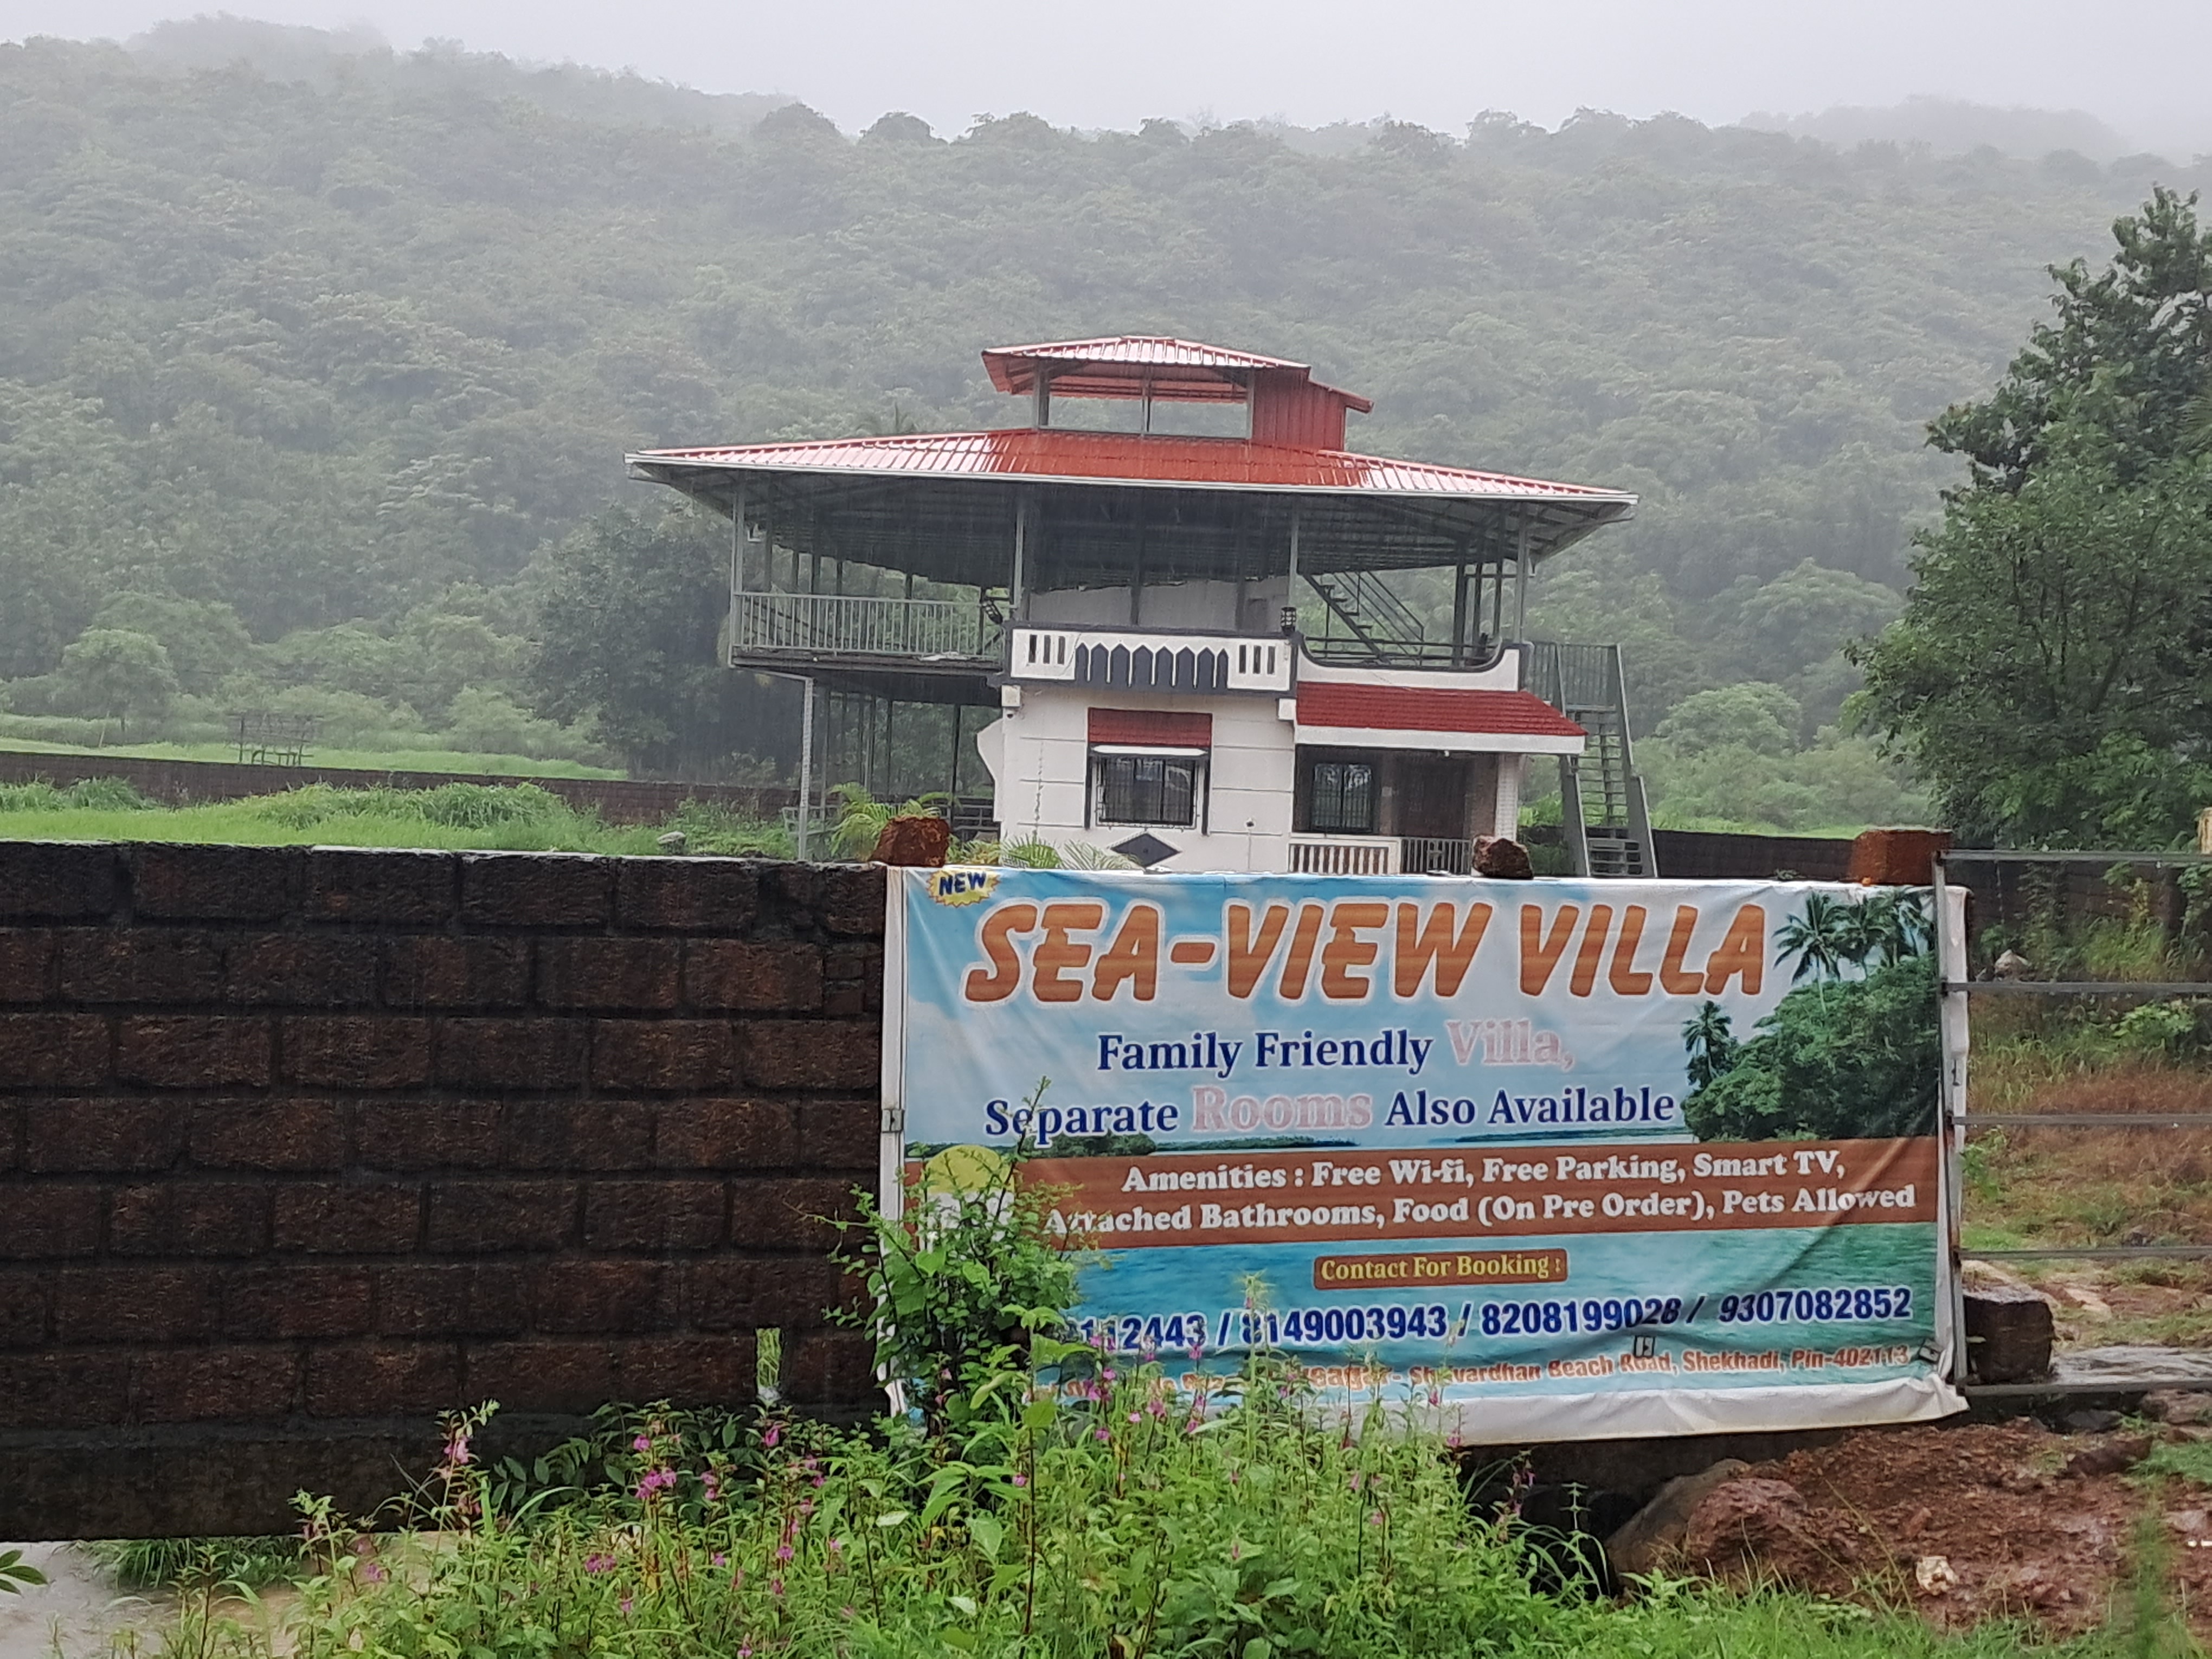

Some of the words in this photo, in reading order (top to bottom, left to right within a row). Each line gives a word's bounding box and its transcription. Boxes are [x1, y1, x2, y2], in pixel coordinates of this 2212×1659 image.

[939, 871, 986, 896] NEW
[965, 902, 1494, 1002] SEA-VIEW
[1520, 903, 1765, 997] VILLA
[1097, 1031, 1243, 1078] Family
[1255, 1029, 1435, 1075] Friendly
[1446, 1019, 1573, 1070] Villa,
[986, 1099, 1179, 1145] Separate
[1193, 1085, 1372, 1130] Rooms
[1385, 1089, 1476, 1126] Also
[1487, 1086, 1674, 1124] Available
[1121, 1163, 1286, 1192] Amenities
[1311, 1161, 1381, 1186] Free
[1388, 1159, 1475, 1188] Wi-fi,
[1482, 1158, 1549, 1182] Free
[1555, 1155, 1686, 1184] Parking,
[1693, 1153, 1787, 1177] Smart
[1793, 1150, 1845, 1179] TV,
[1200, 1203, 1385, 1229] Bathrooms,
[1393, 1198, 1469, 1224] Food
[1478, 1195, 1536, 1227] (On
[1542, 1194, 1594, 1219] Pre
[1602, 1191, 1714, 1221] Order),
[1721, 1190, 1785, 1214] Pets
[1791, 1184, 1917, 1212] Allowed
[1321, 1259, 1409, 1280] Contact
[1413, 1257, 1452, 1278] For
[1457, 1253, 1549, 1279] Booking
[1218, 1312, 1231, 1346] /
[1242, 1305, 1446, 1344] 8149003943
[1458, 1303, 1471, 1336] /
[1481, 1298, 1681, 1335] 8208199028
[1686, 1295, 1706, 1323] /
[1719, 1288, 1911, 1322] 9307082852
[1547, 1355, 1613, 1378] Beach
[1620, 1352, 1678, 1375] Road,
[1683, 1349, 1786, 1373] Shekhadi,
[1791, 1344, 1909, 1369] Pin-402113
